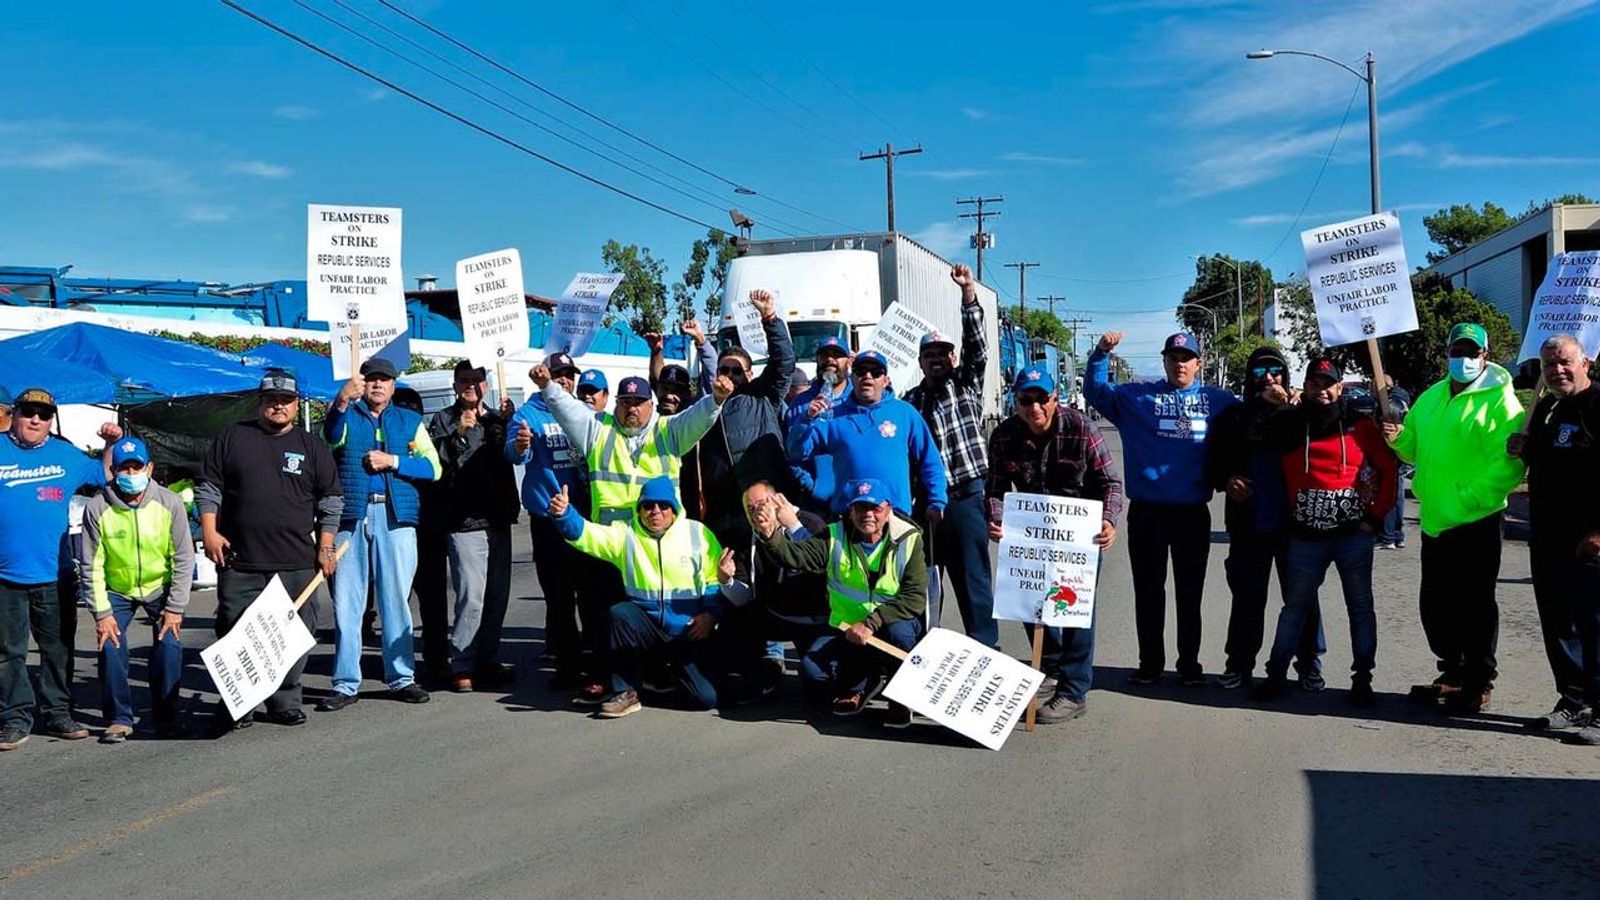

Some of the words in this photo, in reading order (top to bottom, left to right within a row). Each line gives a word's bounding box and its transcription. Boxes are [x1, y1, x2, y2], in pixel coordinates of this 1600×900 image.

[320, 212, 389, 224] TEAMSTERS
[347, 224, 362, 232] ON
[1314, 218, 1387, 243] TEAMSTERS
[331, 235, 378, 248] STRIKE
[1345, 237, 1360, 247] ON
[318, 254, 353, 266] REPUBLIC
[355, 256, 390, 268] SERVICES
[1330, 246, 1379, 265] STRIKE
[464, 256, 512, 274] TEAMSTERS
[320, 274, 354, 284] UNFAIR
[356, 276, 387, 285] LABOR
[484, 270, 494, 279] ON
[1320, 270, 1358, 288] REPUBLIC
[1359, 261, 1397, 280] SERVICES
[330, 285, 378, 294] PRACTICE
[474, 278, 507, 294] STRIKE
[1326, 290, 1363, 304] UNFAIR
[1364, 282, 1398, 298] LABOR
[468, 300, 493, 314] REPUBLIC
[494, 294, 518, 308] SERVICES
[1340, 296, 1389, 313] PRACTICE
[1540, 294, 1571, 305] REPUBLIC
[472, 318, 496, 330] UNFAIR
[498, 312, 520, 323] LABOR
[1534, 313, 1565, 321] UNFAIR
[1566, 312, 1598, 323] LABOR
[370, 328, 397, 339] LABOR
[481, 323, 513, 338] PRACTICE
[891, 323, 918, 344] STRIKE
[905, 322, 914, 331] ON
[1538, 322, 1584, 331] PRACTICE
[1155, 393, 1209, 404] REPUBLIC
[1154, 404, 1210, 418] SERVICES
[1016, 500, 1088, 517] TEAMSTERS
[1043, 515, 1058, 525] ON
[1024, 526, 1075, 542] STRIKE
[1008, 546, 1047, 561] REPUBLIC
[1047, 548, 1087, 565] SERVICES
[1010, 568, 1046, 580] UNFAIR
[1020, 581, 1045, 592] PRAC
[236, 646, 260, 686] STRIKE
[925, 651, 956, 690] PRACTICE
[948, 648, 972, 680] UNFAIR
[964, 655, 993, 688] REPUBLIC
[212, 654, 244, 708] TEAMSTERS
[233, 668, 244, 682] ON
[929, 678, 952, 705] LABOR
[971, 673, 1004, 716] STRIKE
[945, 682, 973, 718] SERVICES
[989, 677, 1033, 738] TEAMSTERS
[994, 694, 1007, 707] ON
